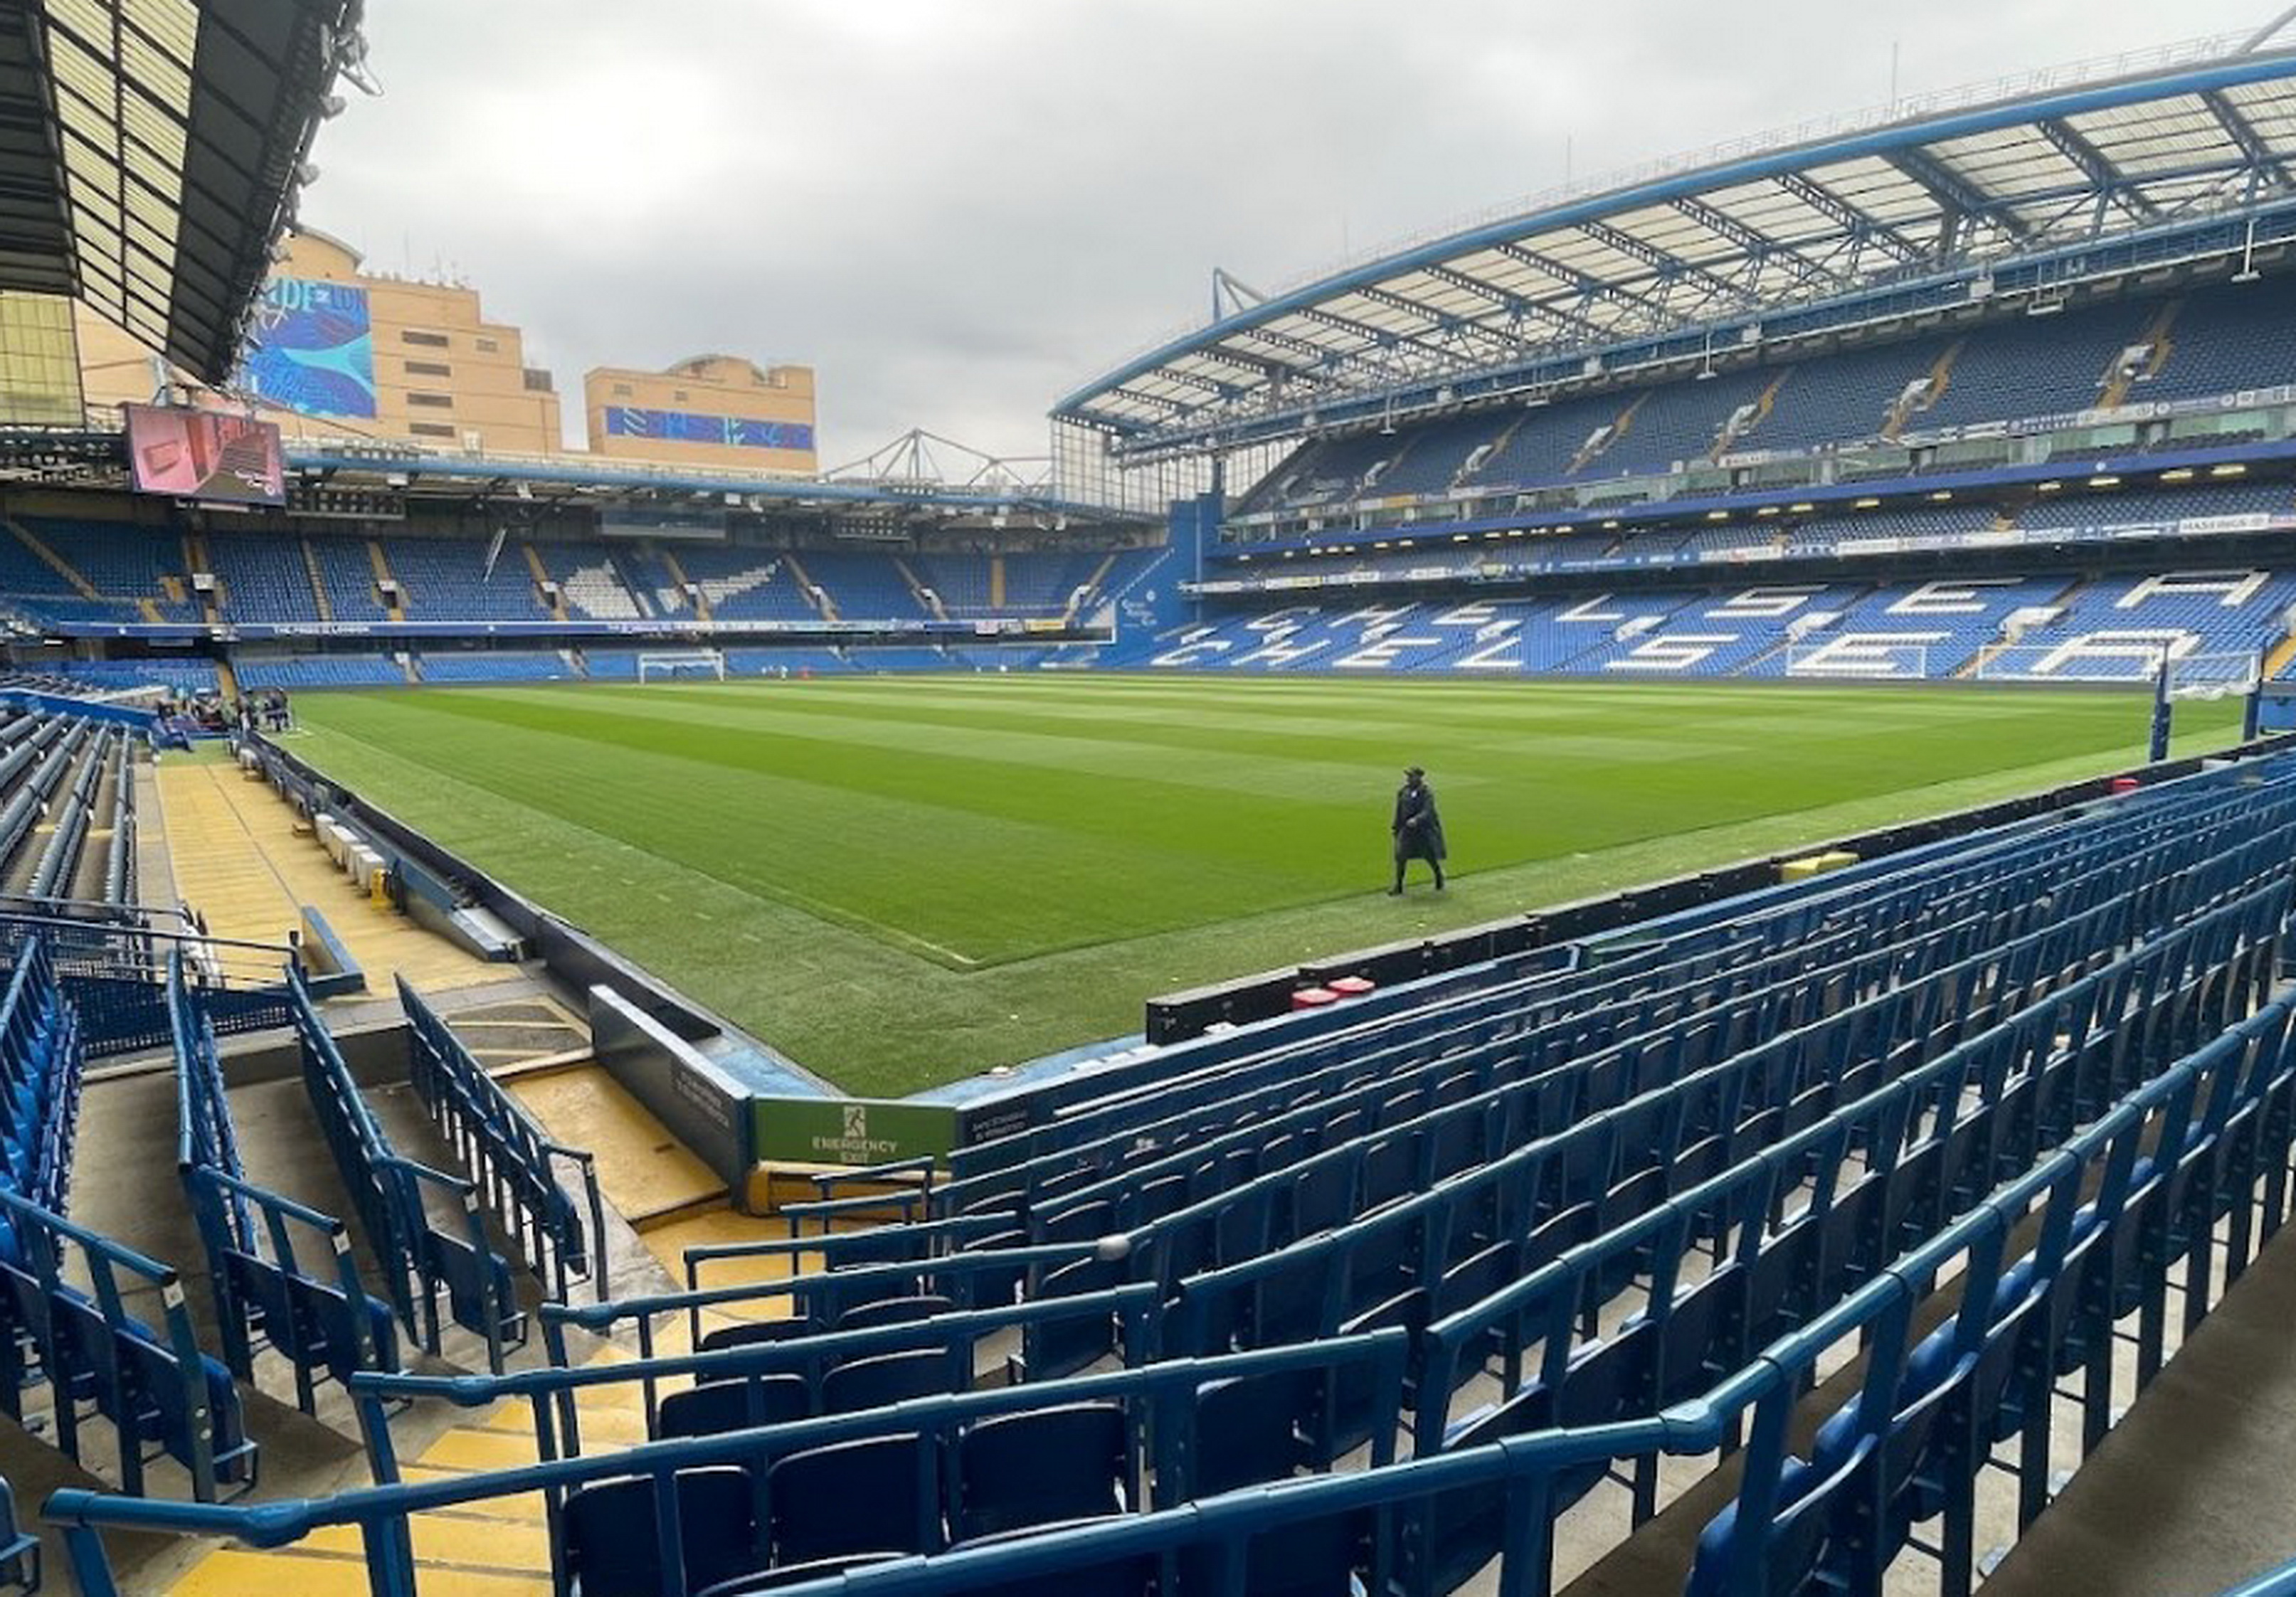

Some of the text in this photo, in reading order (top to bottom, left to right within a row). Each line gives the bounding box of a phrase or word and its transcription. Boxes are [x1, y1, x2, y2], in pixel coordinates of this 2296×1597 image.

[1247, 571, 2270, 630] CHELSEA
[1150, 629, 2201, 674] CHELSEA
[812, 1136, 898, 1153] EMERGENCY
